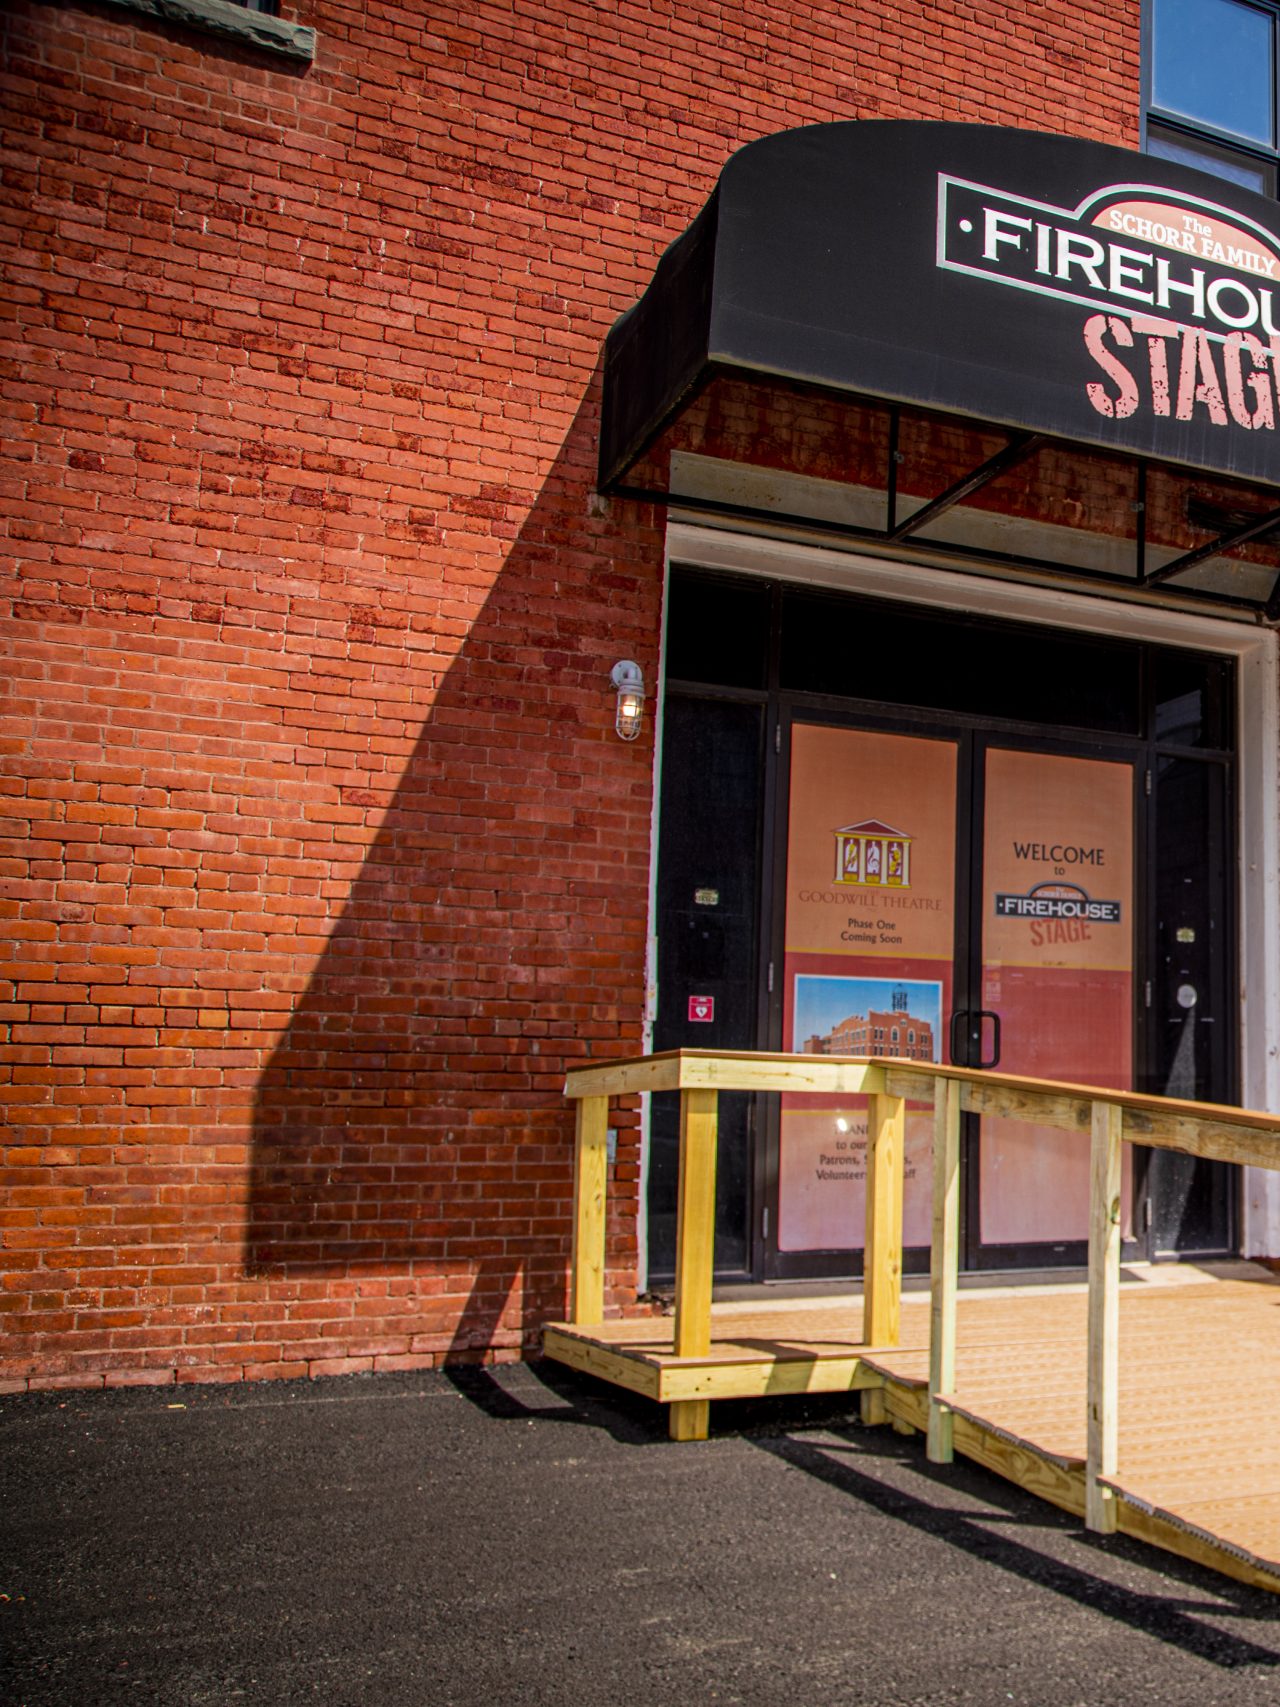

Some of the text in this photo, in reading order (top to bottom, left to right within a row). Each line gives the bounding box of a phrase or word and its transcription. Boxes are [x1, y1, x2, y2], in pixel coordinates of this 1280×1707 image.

[1182, 214, 1213, 238] The
[1109, 209, 1276, 277] SCHORR FAMILY
[1013, 841, 1105, 866] WELCOME
[1054, 866, 1066, 876] to
[798, 890, 943, 911] GOODWILL THEATRE
[1004, 898, 1114, 919] FIREHOUSE
[848, 918, 896, 930] Phase One
[1030, 915, 1092, 947] STAGE
[840, 931, 903, 944] Coming Soon
[836, 1141, 847, 1150] to
[820, 1154, 860, 1166] Patrons,
[816, 1169, 867, 1180] Volunteer
